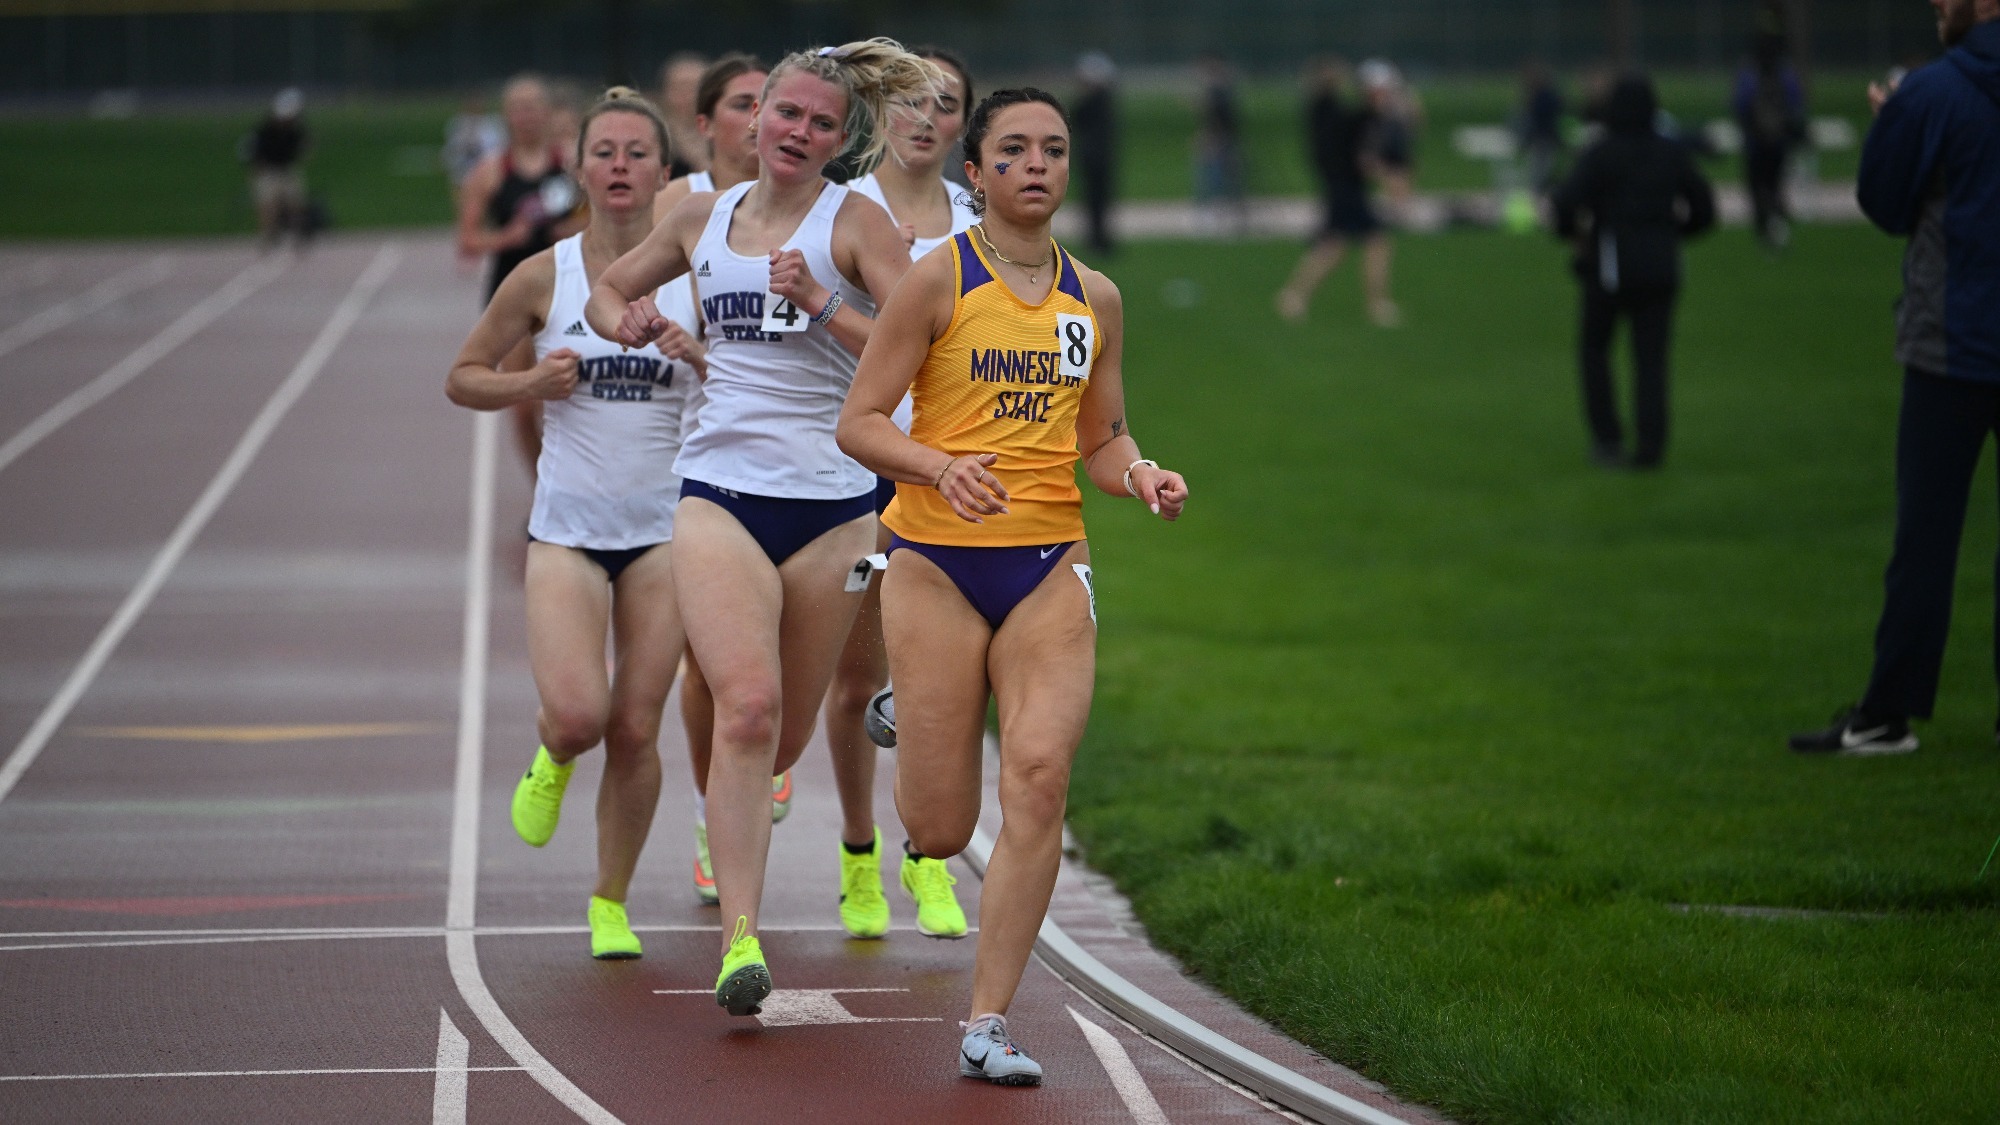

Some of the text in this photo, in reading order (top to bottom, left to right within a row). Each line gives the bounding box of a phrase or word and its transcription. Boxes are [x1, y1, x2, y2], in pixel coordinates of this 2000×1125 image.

[702, 291, 766, 325] WINO
[771, 298, 800, 327] 4
[1065, 321, 1087, 367] 8
[592, 383, 652, 401] STATE
[993, 391, 1054, 423] STATE
[854, 559, 873, 582] 4
